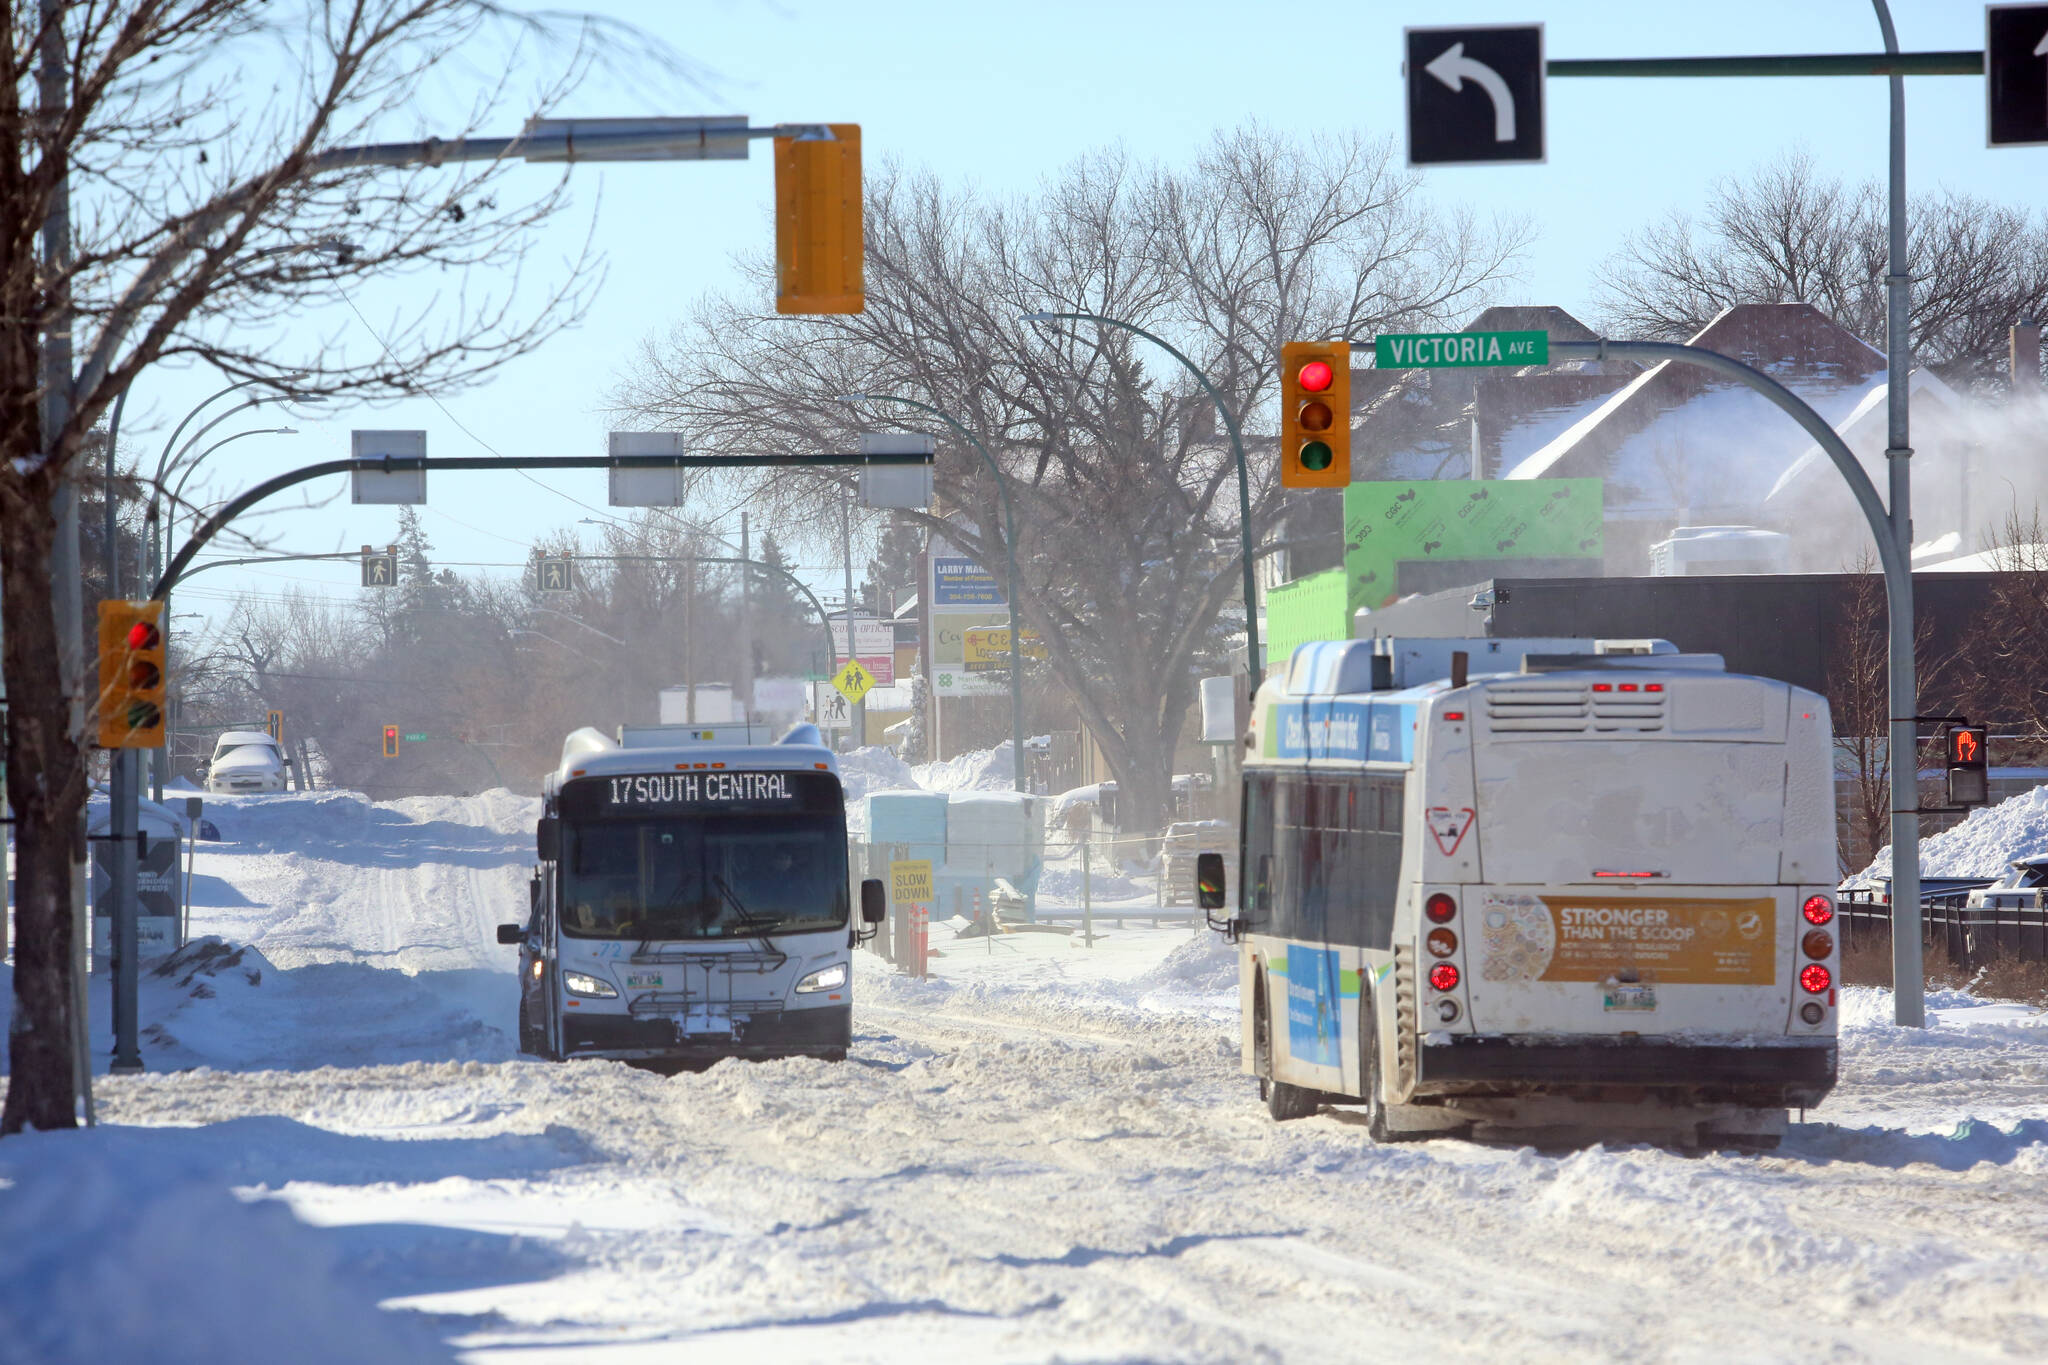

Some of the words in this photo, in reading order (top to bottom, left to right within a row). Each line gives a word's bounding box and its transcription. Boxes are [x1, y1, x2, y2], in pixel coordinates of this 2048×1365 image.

[1390, 337, 1502, 363] VICTORIA
[1508, 341, 1535, 355] AVE
[937, 565, 963, 574] LARRY
[831, 624, 857, 633] SCOTA
[860, 624, 892, 633] OPTICAL
[706, 773, 793, 801] CENTRAL
[896, 873, 926, 887] SLOW
[895, 887, 929, 900] DOWN
[1560, 908, 1668, 926] STRONGER
[1561, 926, 1604, 939] THAN
[1608, 926, 1637, 939] THE
[1641, 927, 1695, 941] SCOOP
